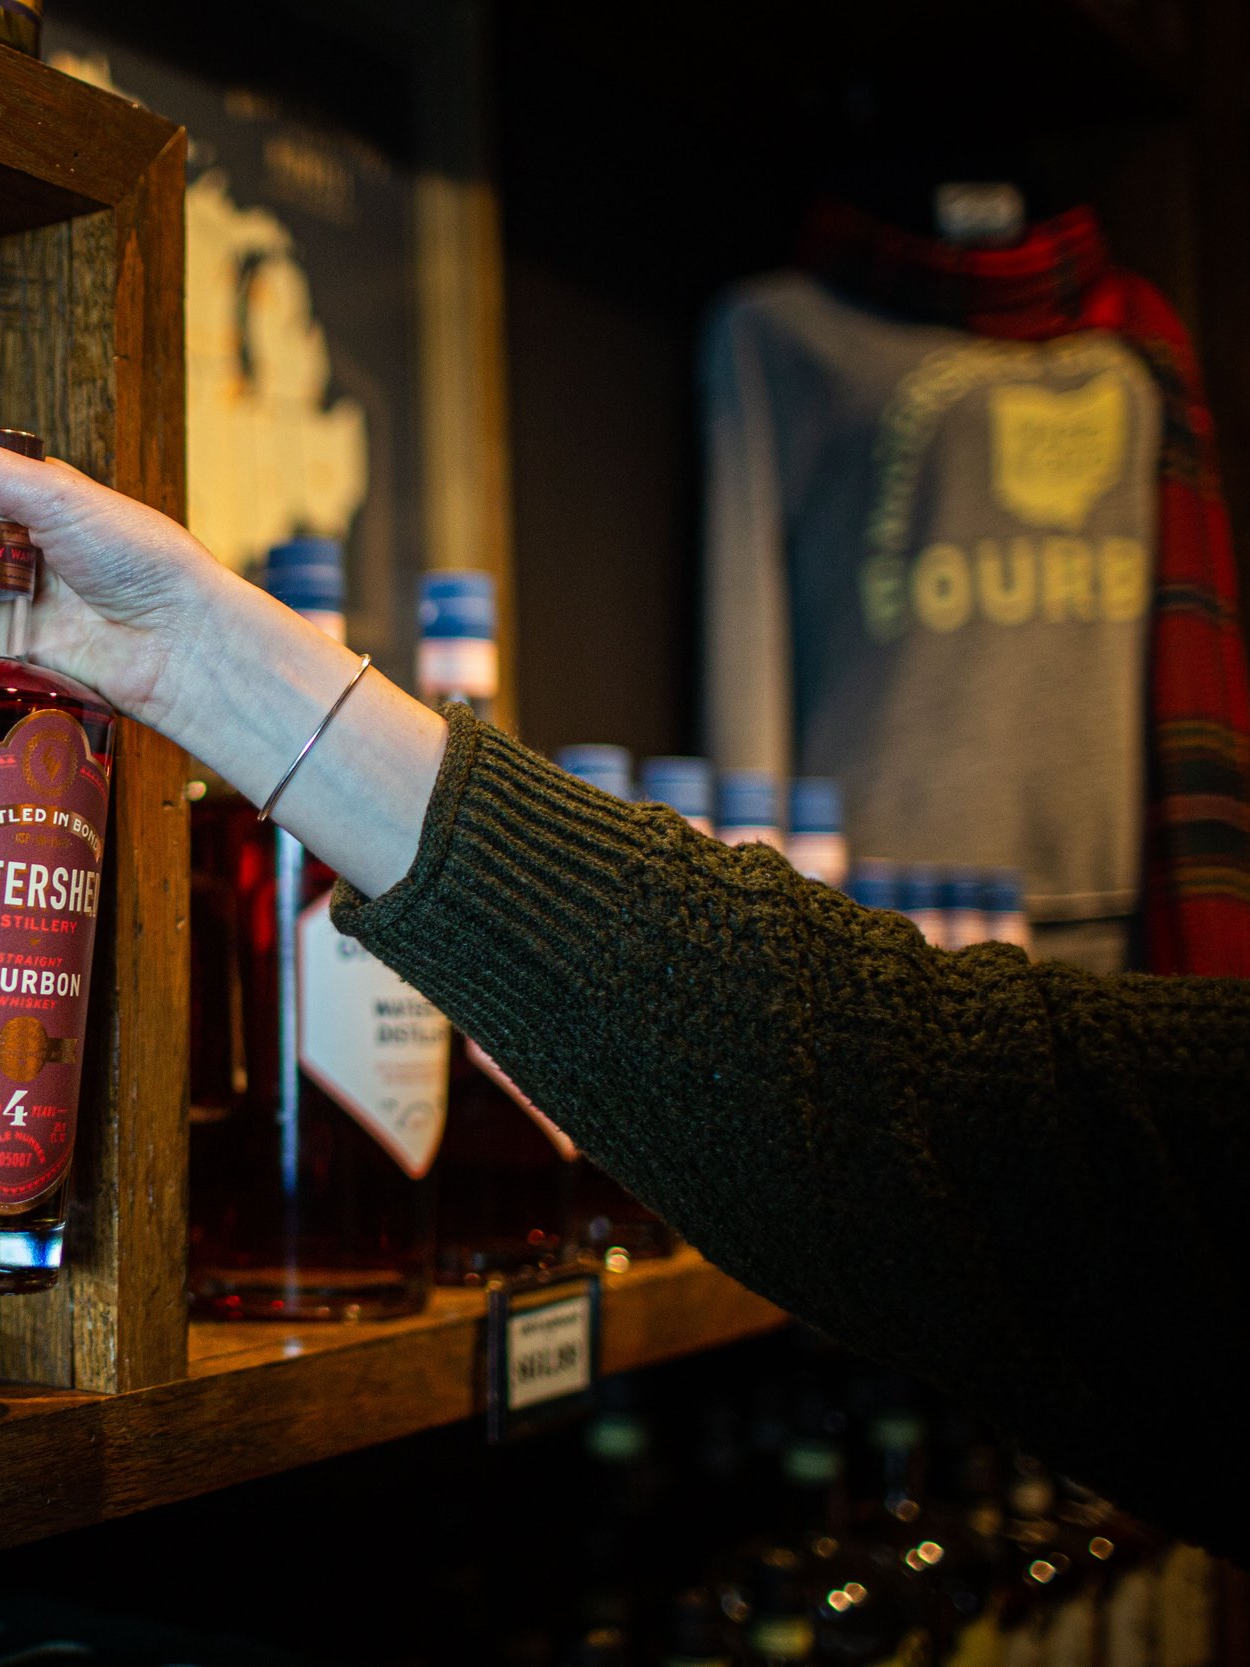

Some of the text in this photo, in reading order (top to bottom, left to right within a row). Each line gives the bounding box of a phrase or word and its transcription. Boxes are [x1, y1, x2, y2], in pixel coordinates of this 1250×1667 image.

[53, 810, 69, 828] IN
[72, 817, 102, 852] BOND
[2, 1089, 29, 1127] 4
